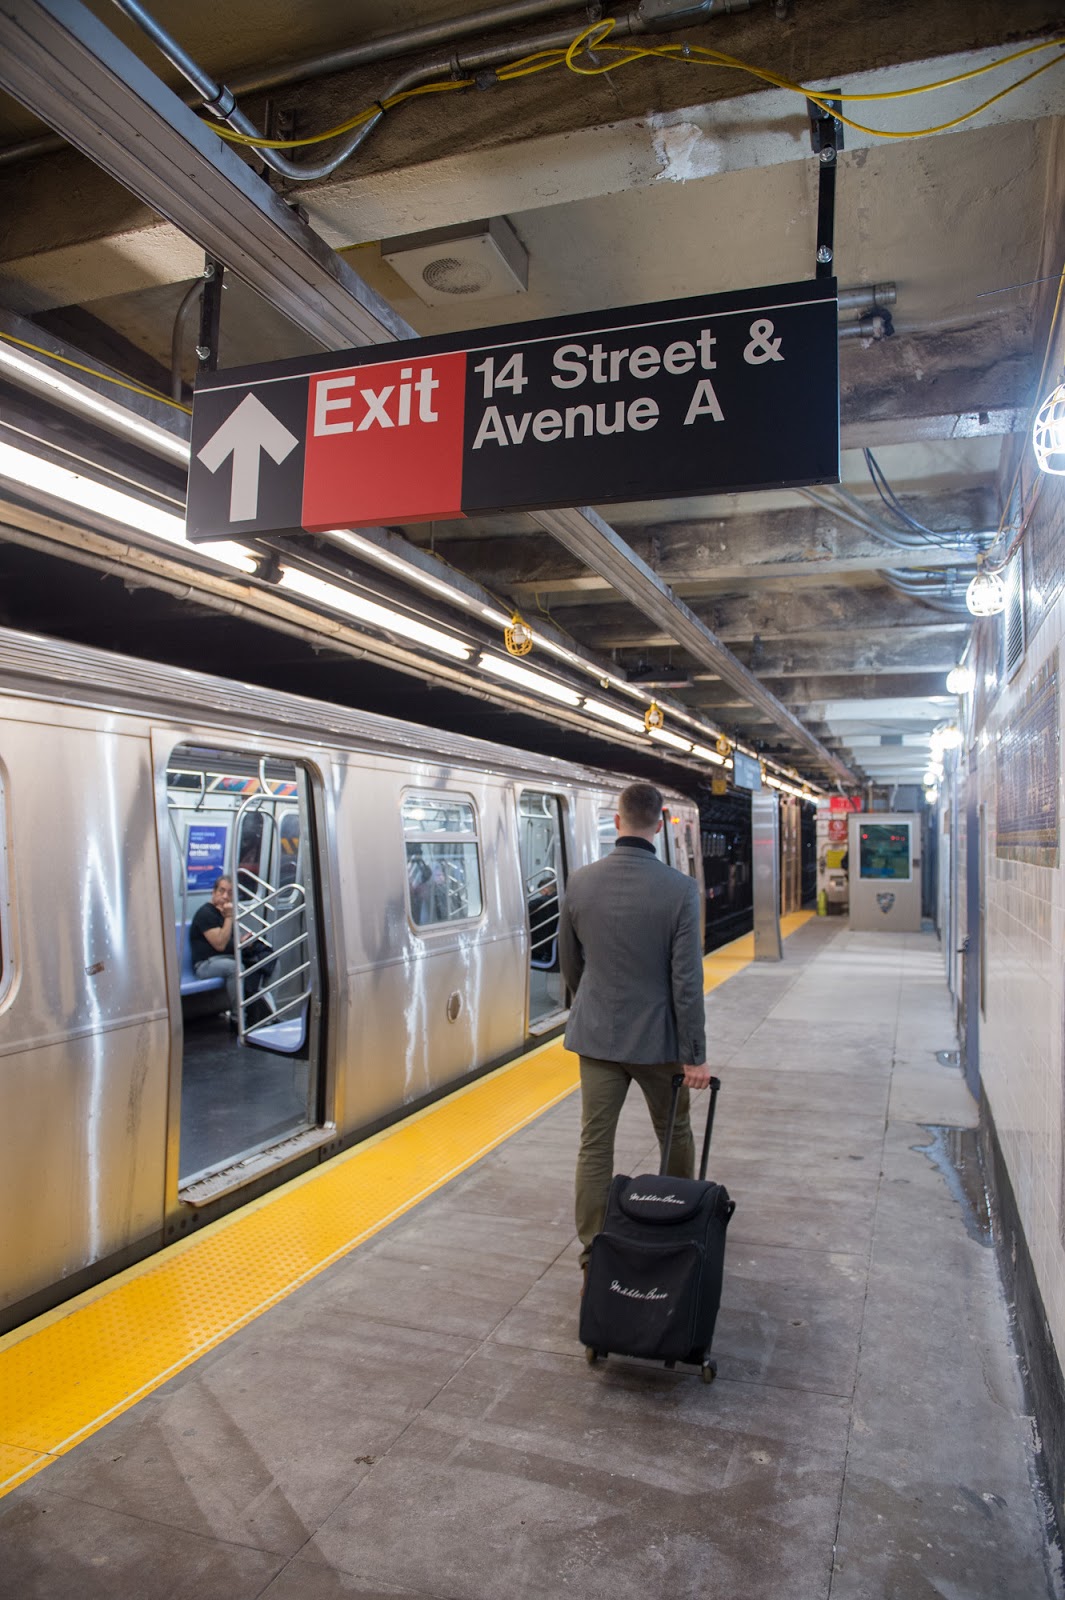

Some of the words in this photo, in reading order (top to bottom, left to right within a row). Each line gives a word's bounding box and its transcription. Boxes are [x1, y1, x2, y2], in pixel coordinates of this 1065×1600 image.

[474, 352, 528, 399] 14
[551, 329, 717, 389] Street
[743, 318, 785, 365] &
[313, 367, 440, 437] Exit
[471, 397, 660, 450] Avenue
[683, 379, 725, 425] A
